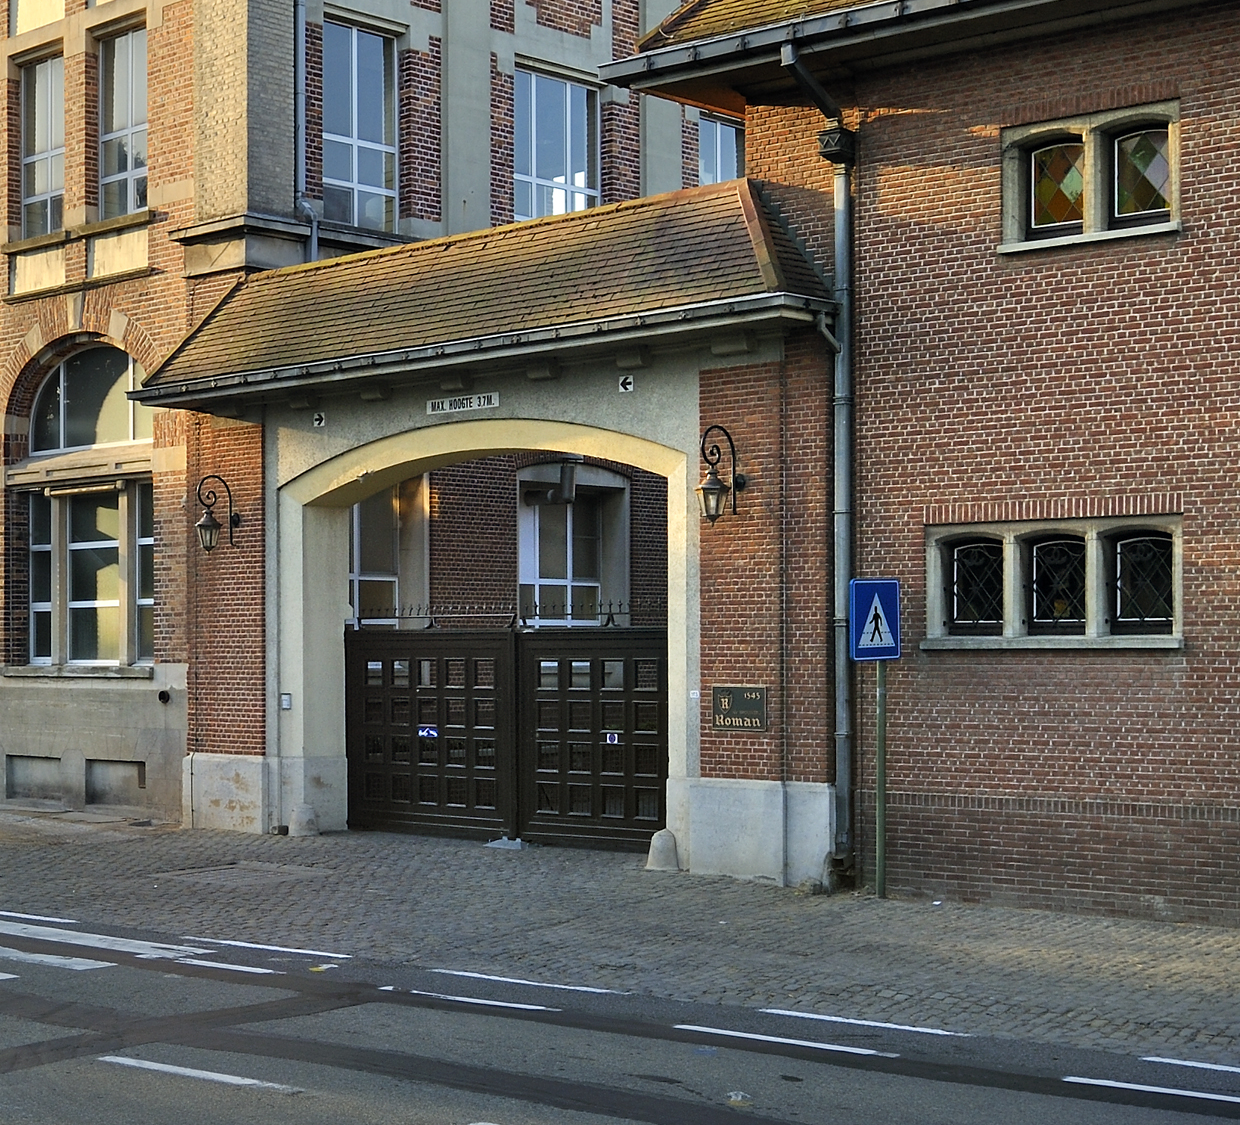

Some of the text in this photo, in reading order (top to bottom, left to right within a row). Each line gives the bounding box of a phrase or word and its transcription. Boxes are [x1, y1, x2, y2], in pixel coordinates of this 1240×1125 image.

[431, 401, 446, 412] MAX.
[449, 397, 473, 410] HOOGTE
[744, 692, 760, 700] 1545
[715, 714, 761, 727] Roman
